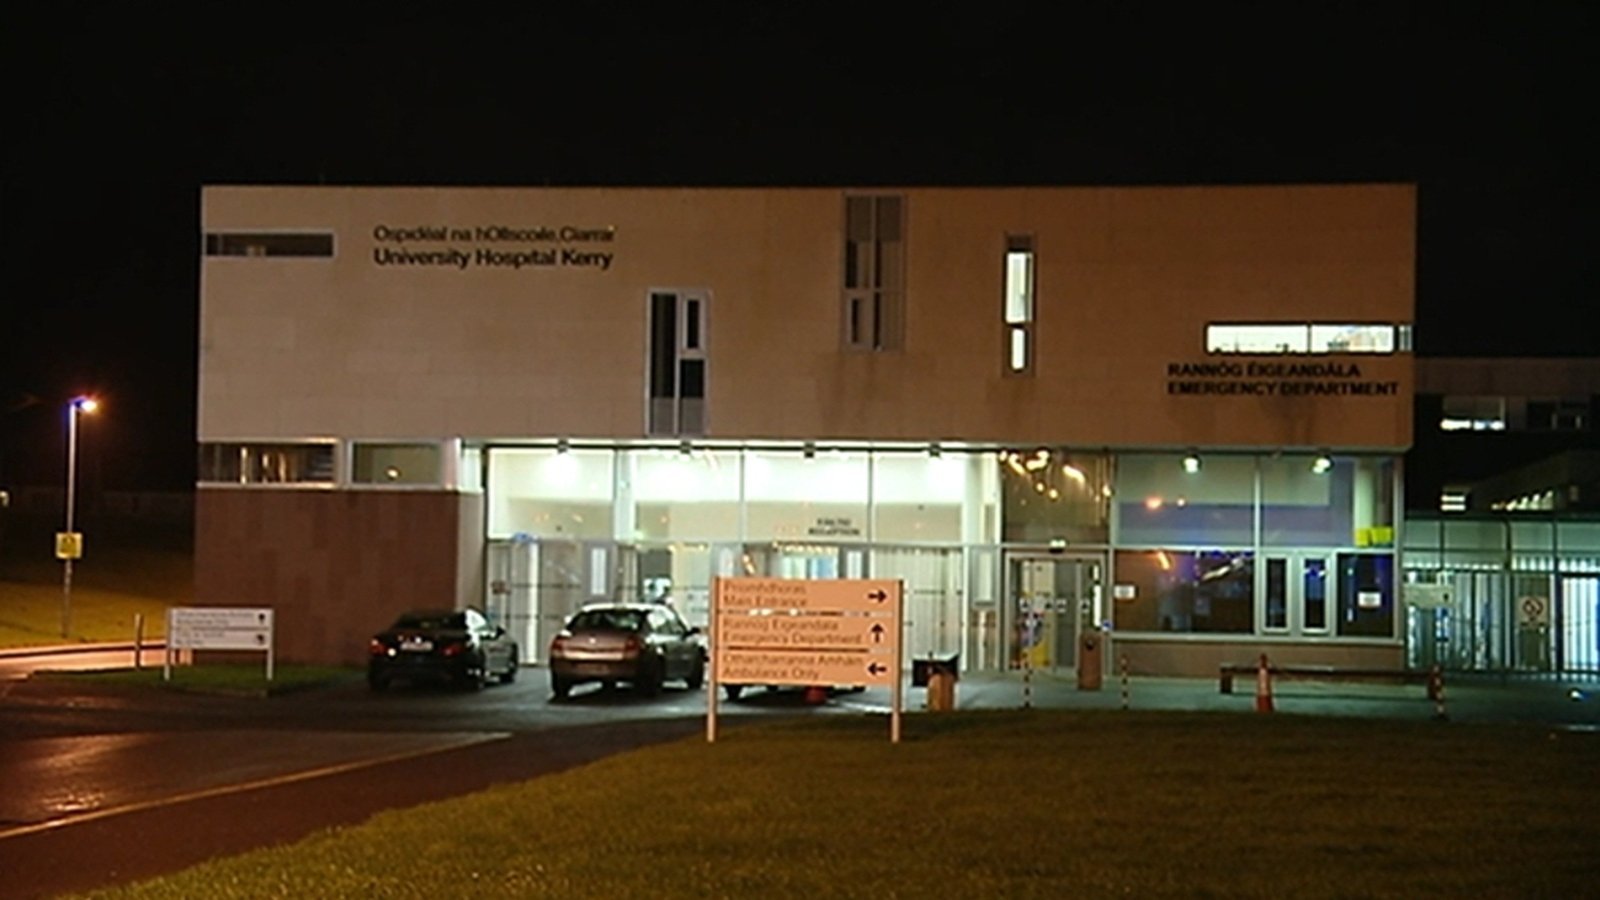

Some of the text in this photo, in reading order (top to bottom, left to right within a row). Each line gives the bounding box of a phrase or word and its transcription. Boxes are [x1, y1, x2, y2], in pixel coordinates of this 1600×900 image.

[451, 229, 473, 242] na
[374, 248, 614, 270] University Hospital Kerry
[1167, 380, 1399, 396] EMERGENCY DEPARTMENT
[723, 594, 807, 608] Main Entrance
[723, 631, 862, 645] Emergency Department
[722, 666, 820, 681] Ambulance Only
